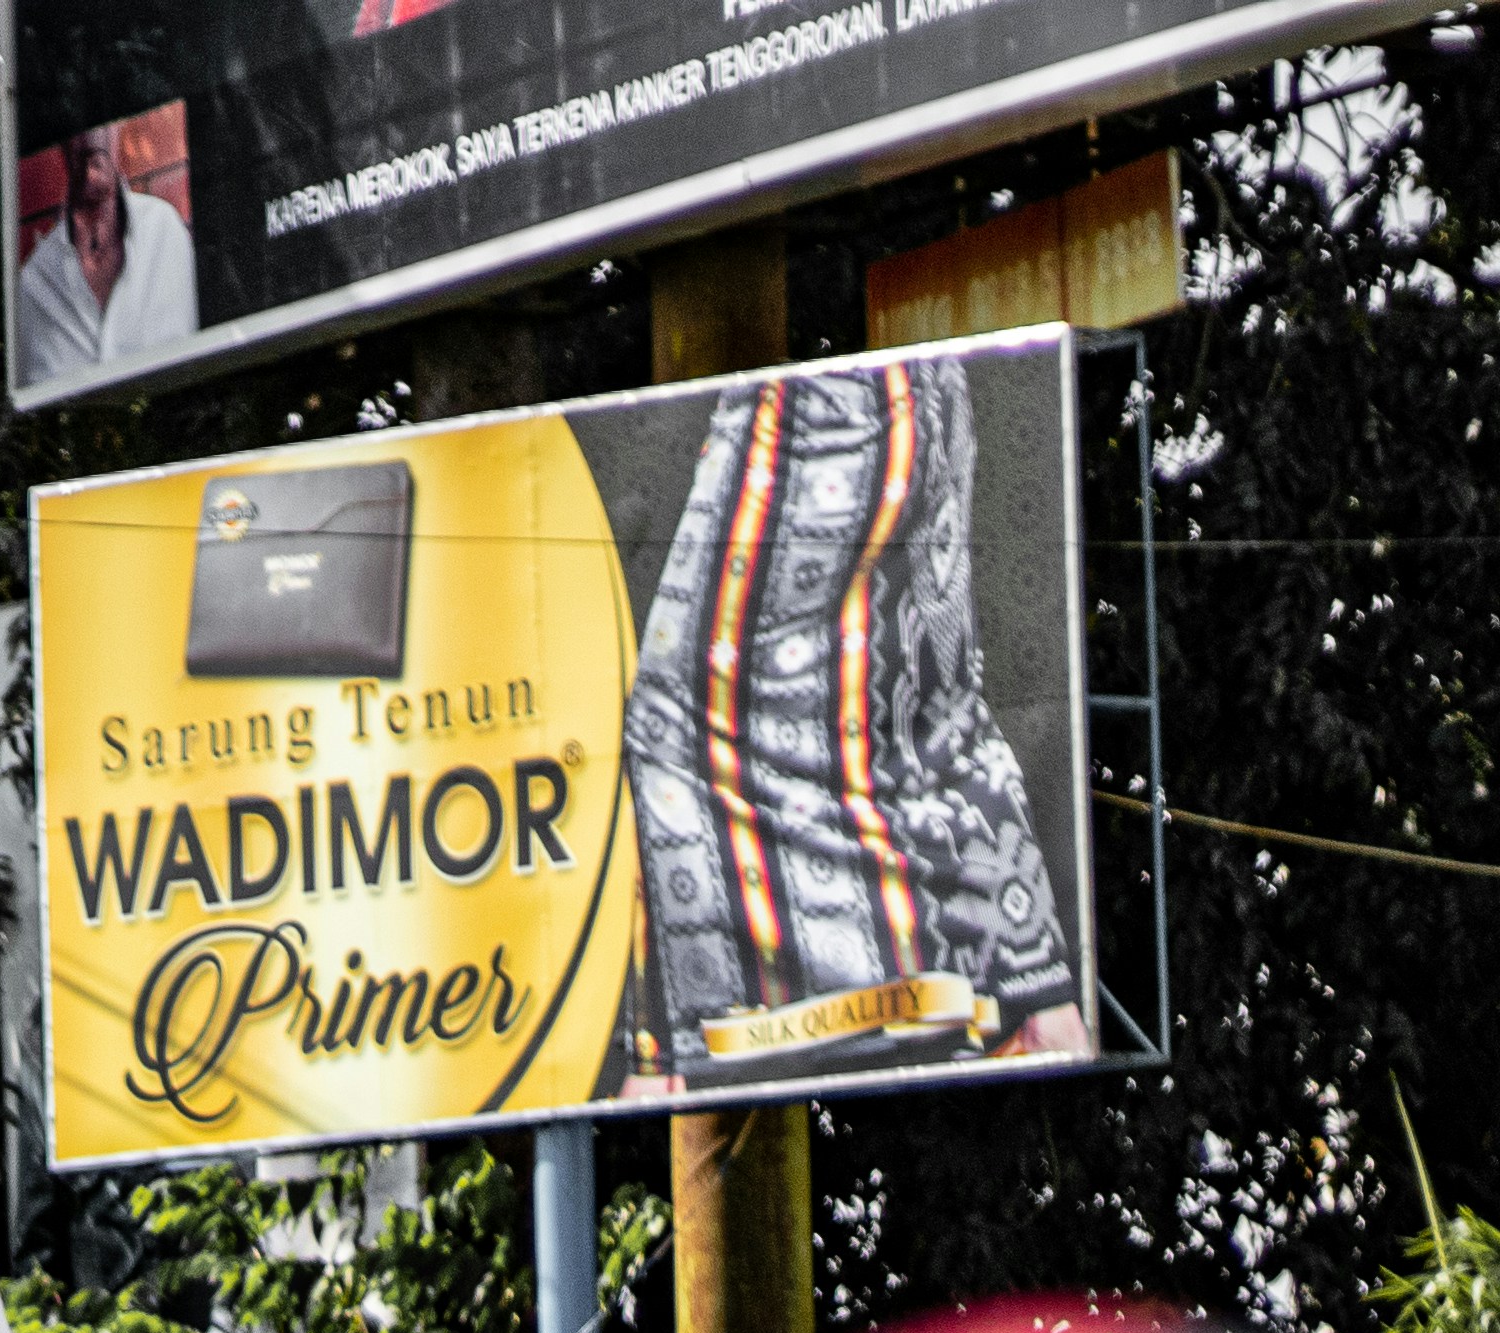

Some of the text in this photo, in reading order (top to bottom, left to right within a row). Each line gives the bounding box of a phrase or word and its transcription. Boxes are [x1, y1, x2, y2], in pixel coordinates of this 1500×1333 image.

[265, 178, 350, 237] KARENA
[455, 122, 517, 177] SAYA
[513, 89, 617, 155] TERKENA
[614, 58, 708, 125] KANKER
[101, 676, 537, 773] Sarung Tenun
[63, 755, 575, 923] WADIMOR
[124, 919, 532, 1124] Primer
[745, 981, 925, 1049] SILK QUALITY
